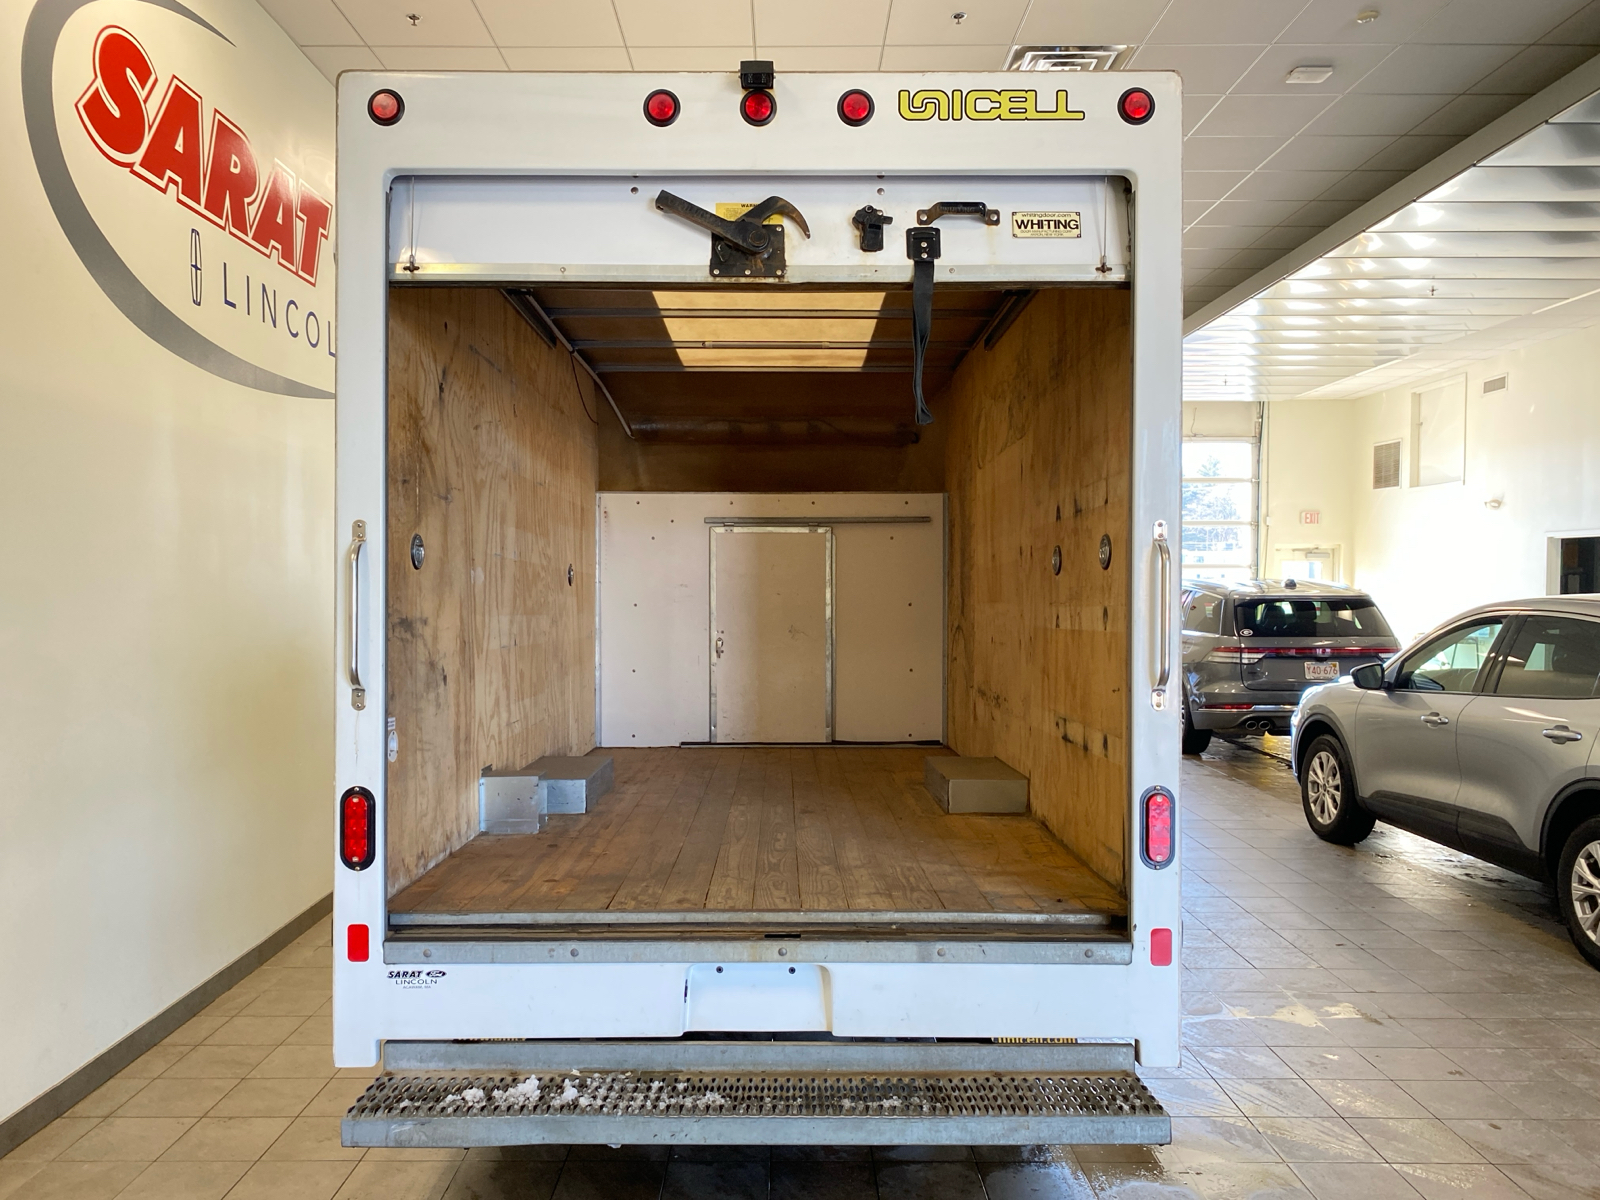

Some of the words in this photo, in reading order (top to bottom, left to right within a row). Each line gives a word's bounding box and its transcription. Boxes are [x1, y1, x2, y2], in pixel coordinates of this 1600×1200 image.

[898, 89, 1086, 121] UNICELL
[75, 24, 333, 288] SARAT
[1015, 219, 1079, 230] WHITING
[223, 262, 336, 358] LINCOL
[1304, 512, 1320, 524] EXIT
[387, 970, 423, 979] SARAT
